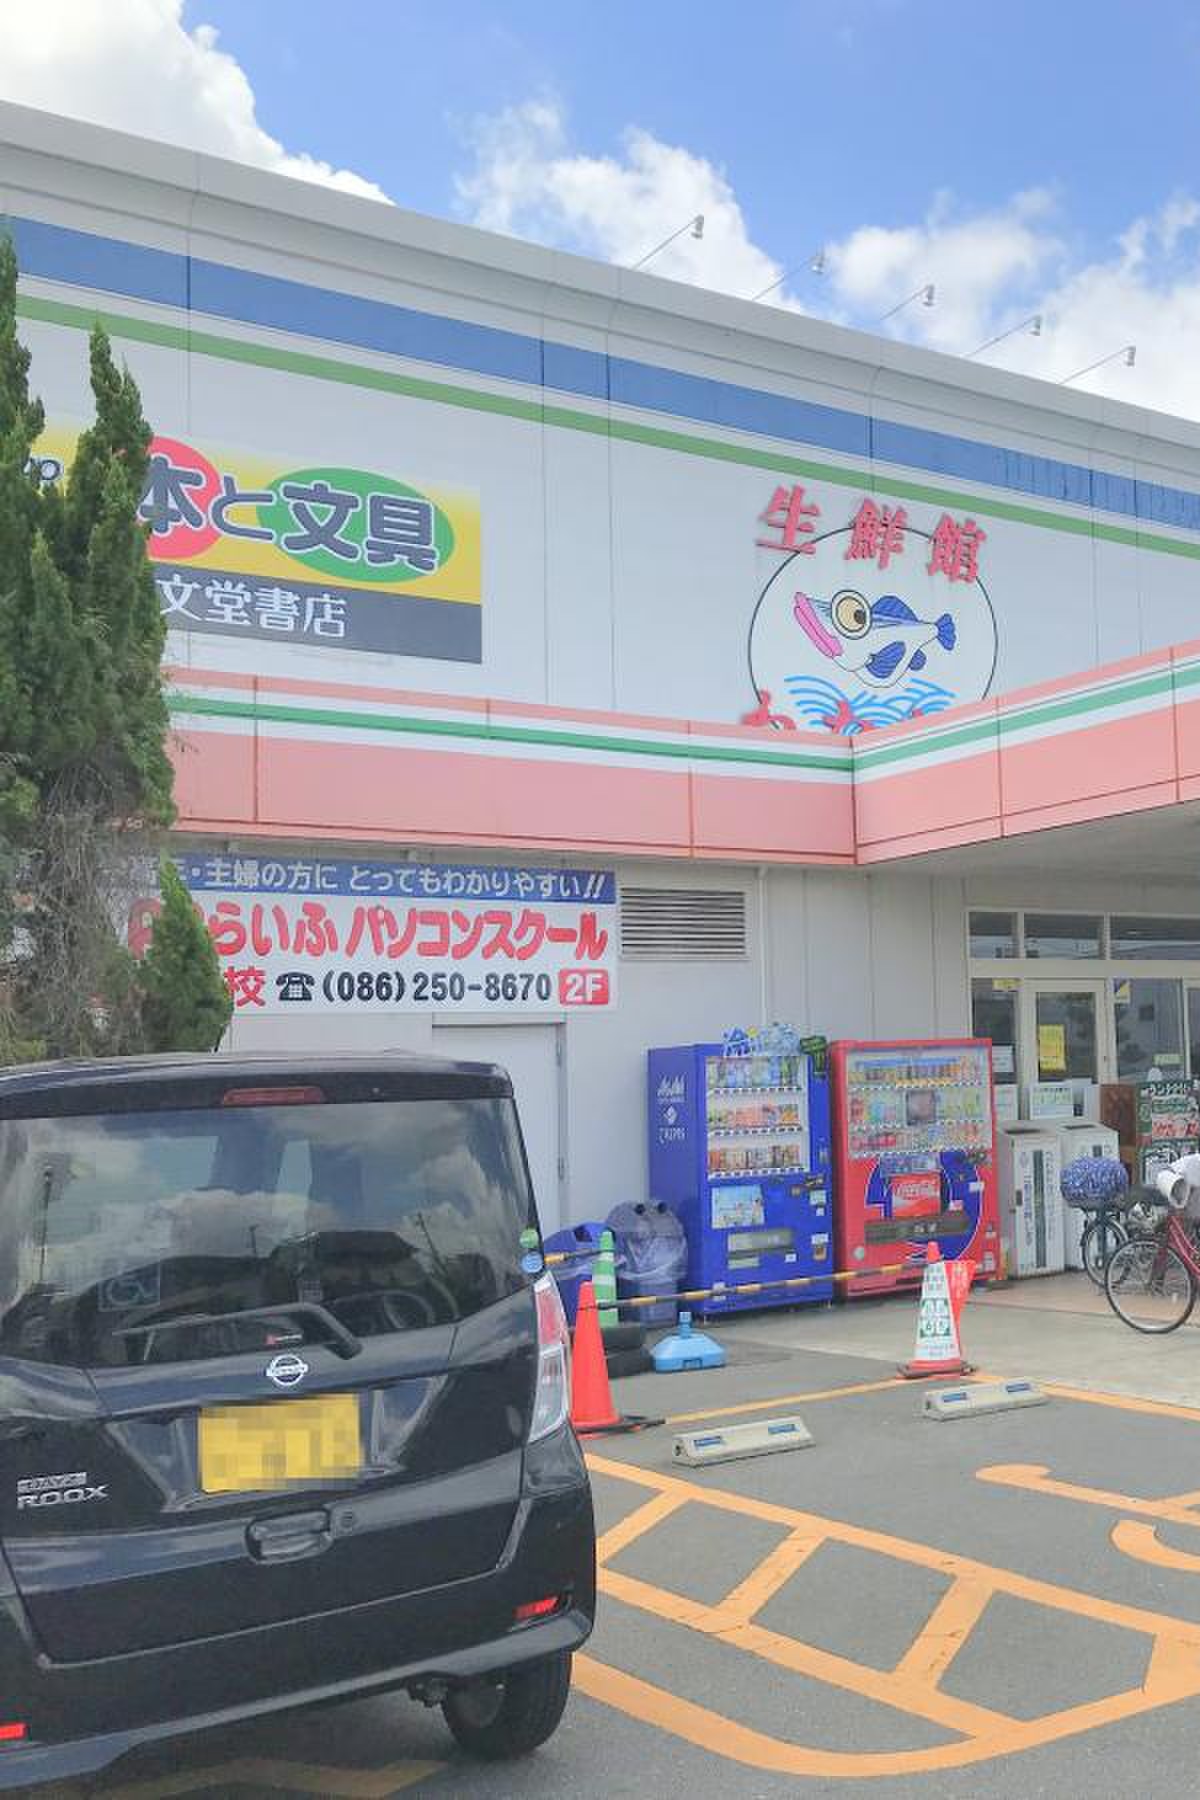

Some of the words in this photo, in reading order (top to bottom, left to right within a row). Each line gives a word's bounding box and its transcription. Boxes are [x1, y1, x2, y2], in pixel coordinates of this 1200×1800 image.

[756, 484, 987, 584] 生鮮館
[565, 973, 606, 1003] 2F
